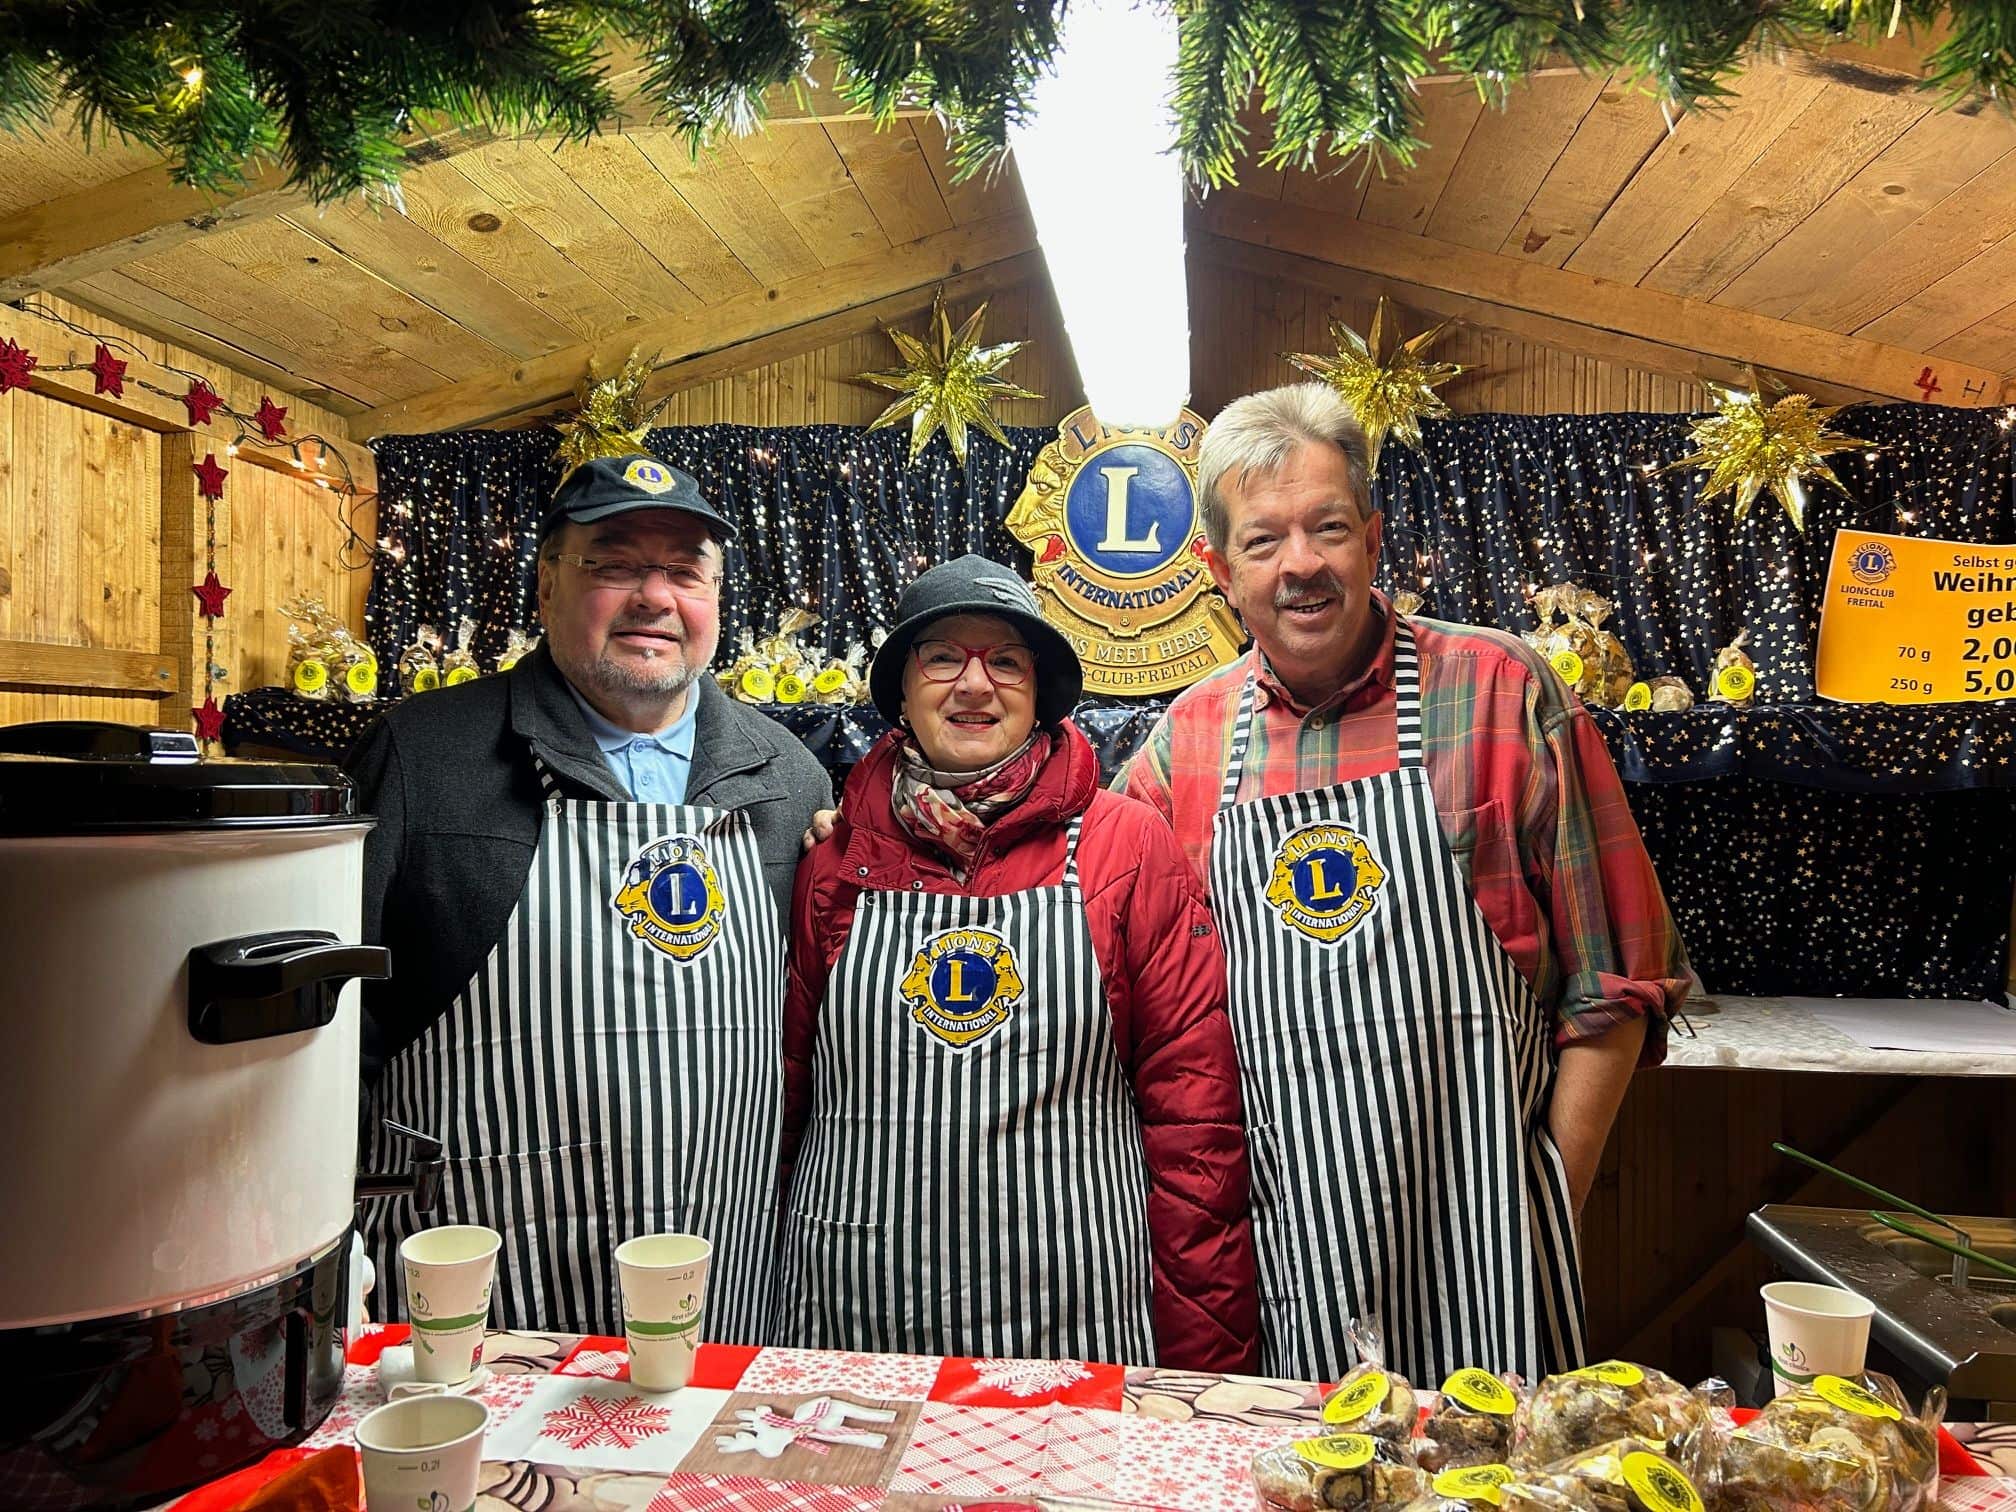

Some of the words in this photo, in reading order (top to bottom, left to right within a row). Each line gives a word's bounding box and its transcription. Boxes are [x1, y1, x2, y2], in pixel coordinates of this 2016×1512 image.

[1914, 366, 1943, 402] 4
[1097, 466, 1161, 553] L
[1860, 543, 1889, 555] LIONS
[1865, 554, 1879, 570] L
[1953, 554, 2000, 568] Selbst
[2004, 558, 2016, 570] g
[1056, 563, 1201, 609] INTERNATIONAL
[1840, 584, 1895, 598] LIONSCLUB
[1847, 597, 1885, 609] FREITAL
[1967, 601, 2016, 629] geb
[1095, 643, 1150, 664] MEET
[1157, 623, 1212, 659] HERE
[1898, 646, 1917, 659] 70
[1921, 650, 1931, 663] g
[1962, 637, 2016, 664] 2,0
[1890, 678, 1919, 691] 250
[1923, 682, 1933, 695] g
[1964, 669, 2015, 696] 5,0
[1291, 831, 1350, 857] LIONS
[1307, 858, 1343, 901] L
[670, 872, 697, 916] L
[1292, 902, 1362, 928] INTERNATIONAL
[935, 935, 995, 955] LIONS
[945, 959, 973, 1002] L
[924, 1008, 997, 1031] INTERNATIONAL
